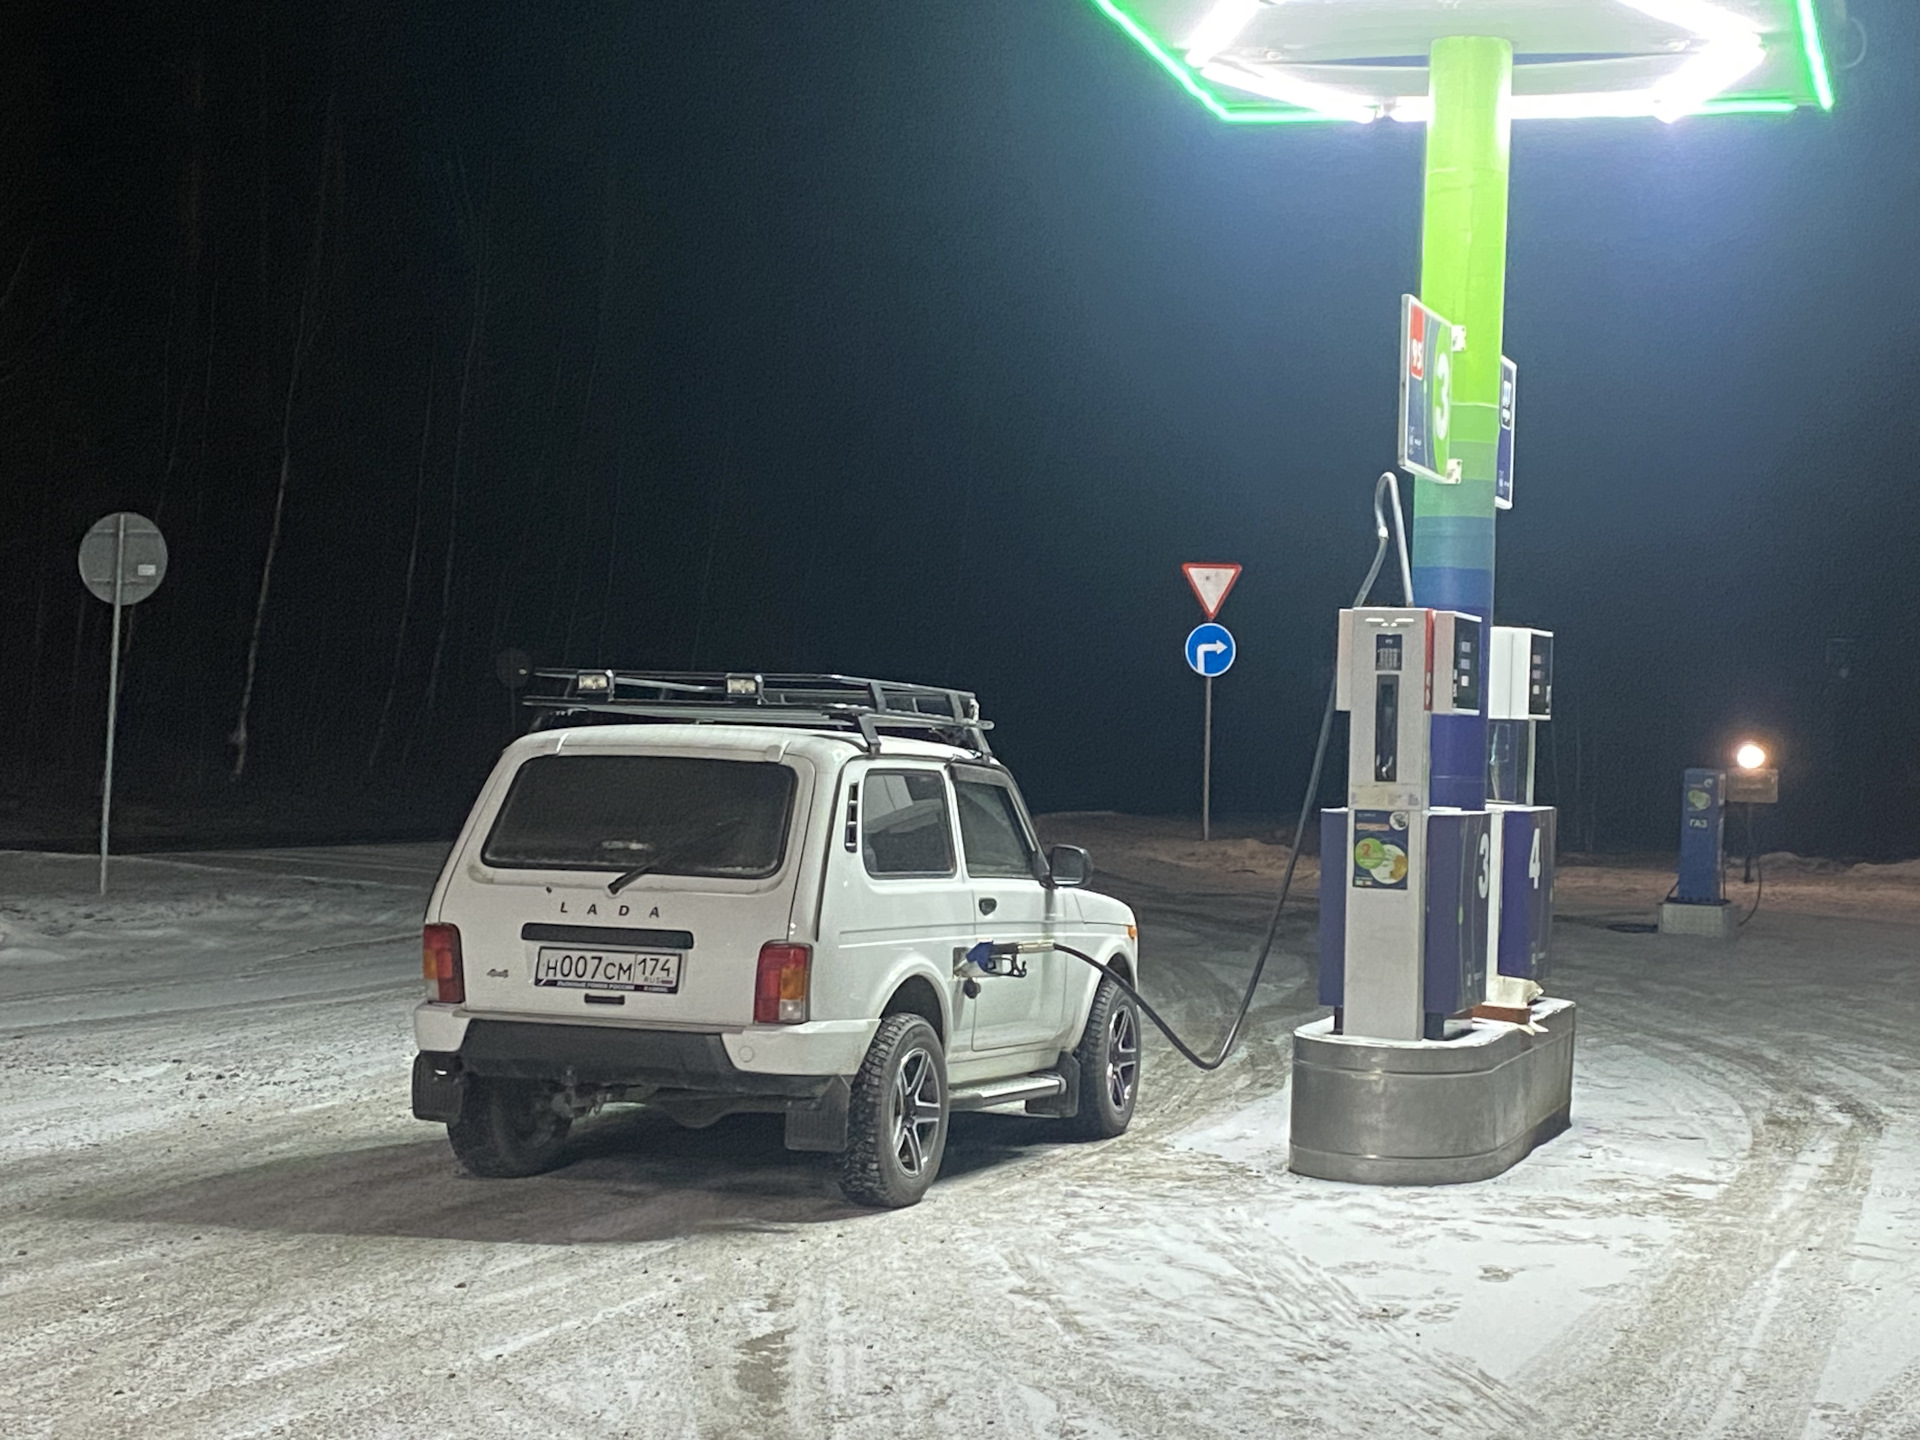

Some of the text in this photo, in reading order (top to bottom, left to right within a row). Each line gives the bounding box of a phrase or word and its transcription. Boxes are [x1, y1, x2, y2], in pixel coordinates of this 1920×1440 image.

[1411, 339, 1423, 370] 95
[1435, 352, 1449, 441] 3
[1690, 818, 1708, 828] ГАЗ
[1478, 832, 1490, 899] 3
[1529, 828, 1541, 889] 4
[560, 901, 660, 919] LADA
[637, 957, 671, 978] 174
[643, 977, 661, 985] RUS
